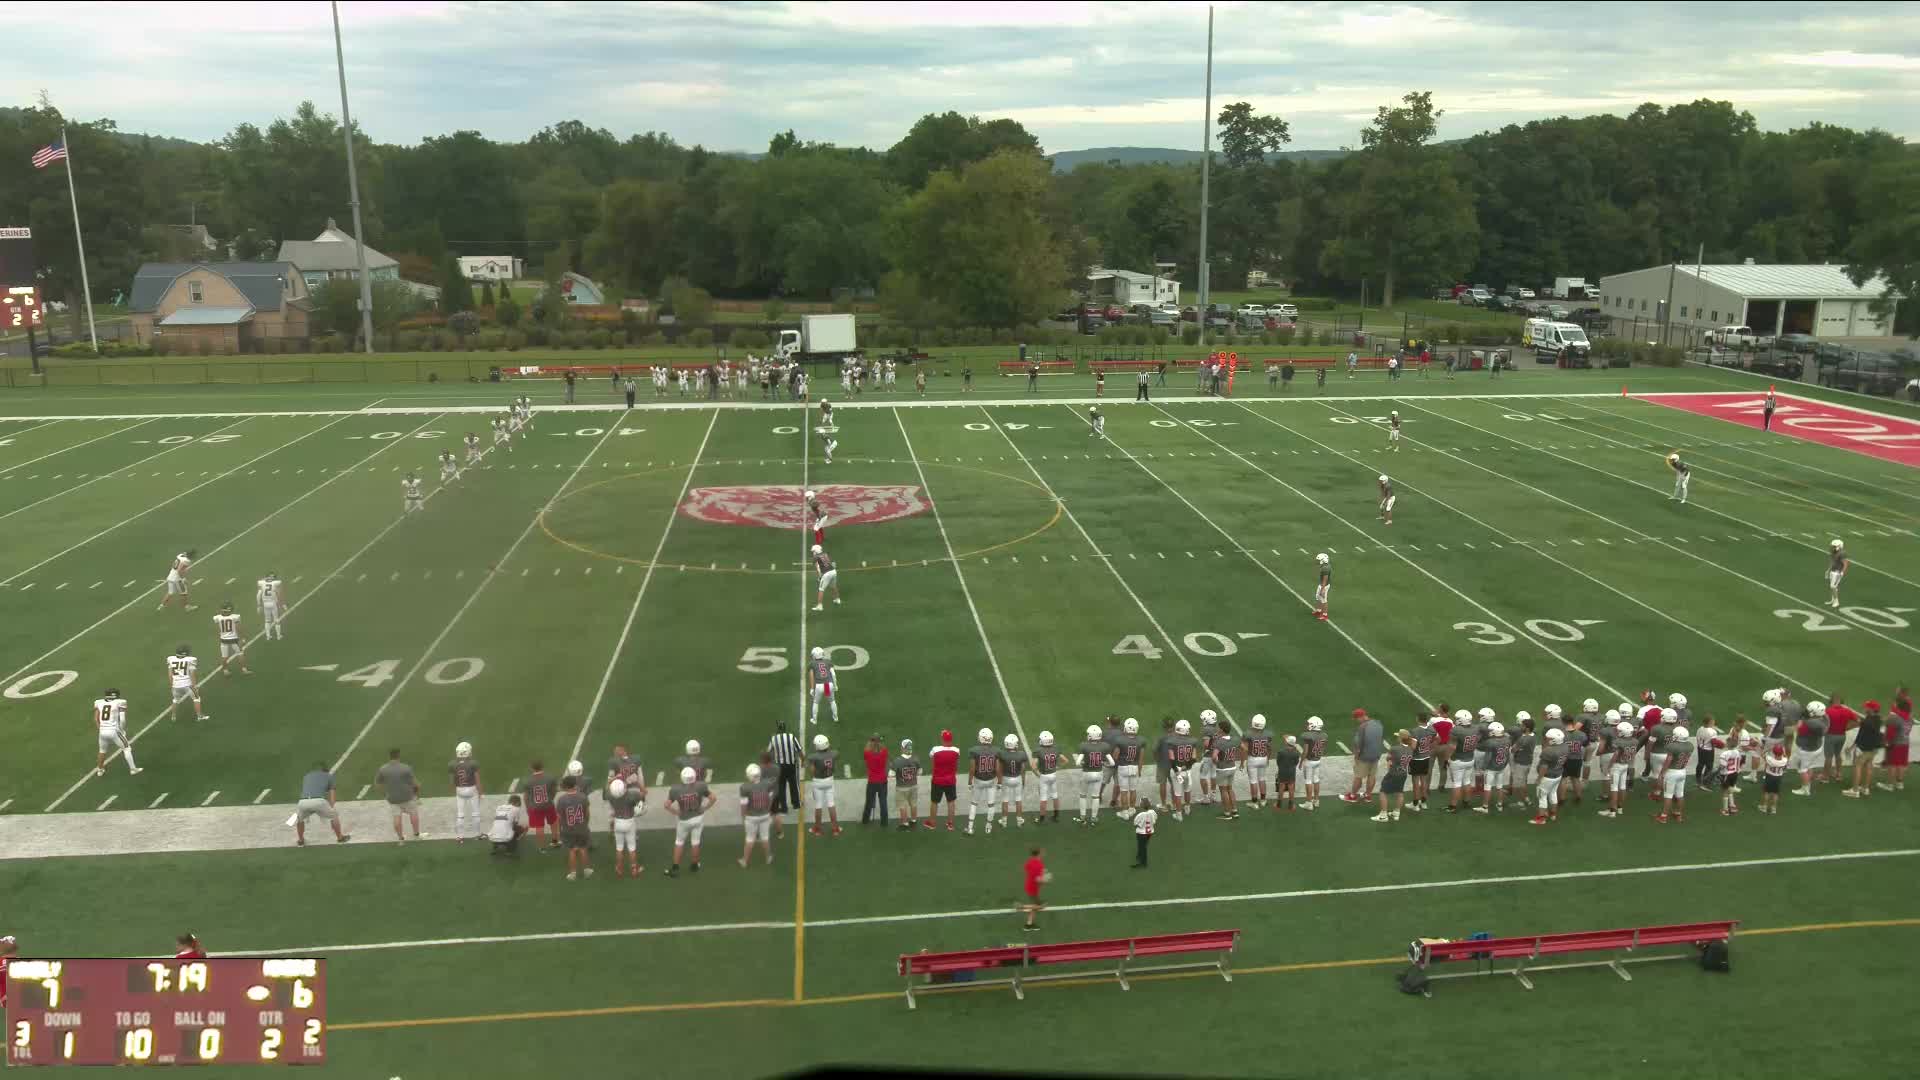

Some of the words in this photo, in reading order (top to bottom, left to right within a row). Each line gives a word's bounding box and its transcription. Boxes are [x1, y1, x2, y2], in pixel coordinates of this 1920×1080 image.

[220, 618, 233, 632] 10
[1773, 605, 1908, 631] 20
[1452, 620, 1585, 645] 30
[736, 645, 869, 673] 50
[1112, 632, 1237, 666] 40
[171, 661, 188, 676] 24
[335, 657, 484, 687] 40
[818, 663, 827, 677] 5
[101, 704, 111, 720] 8
